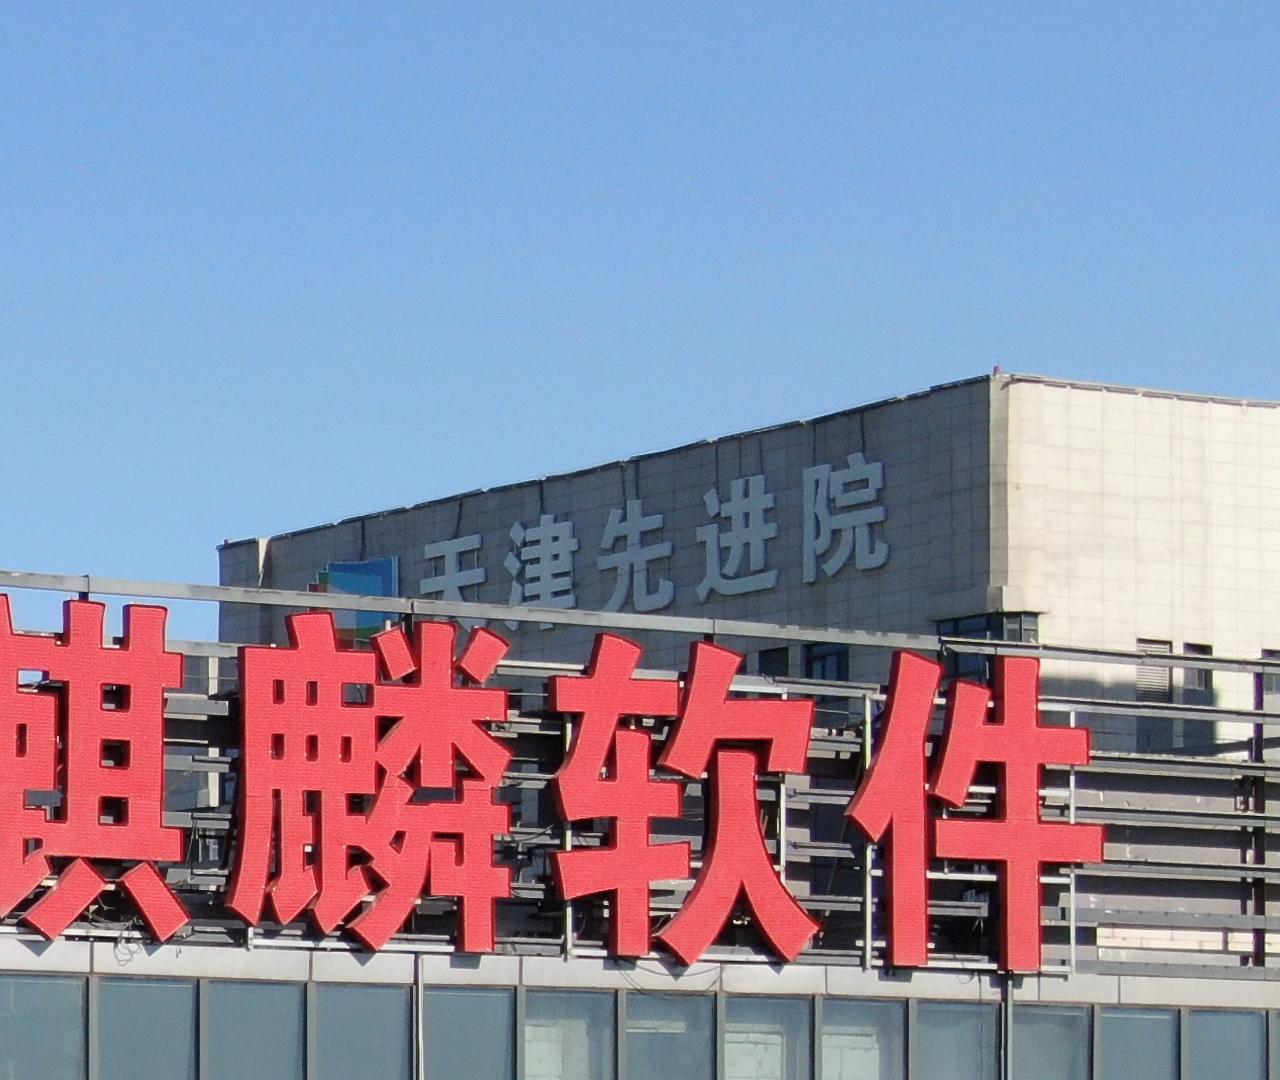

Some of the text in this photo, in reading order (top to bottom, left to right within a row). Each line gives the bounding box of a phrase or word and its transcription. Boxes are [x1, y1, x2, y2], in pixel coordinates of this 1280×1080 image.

[419, 452, 891, 632] 天津先进院
